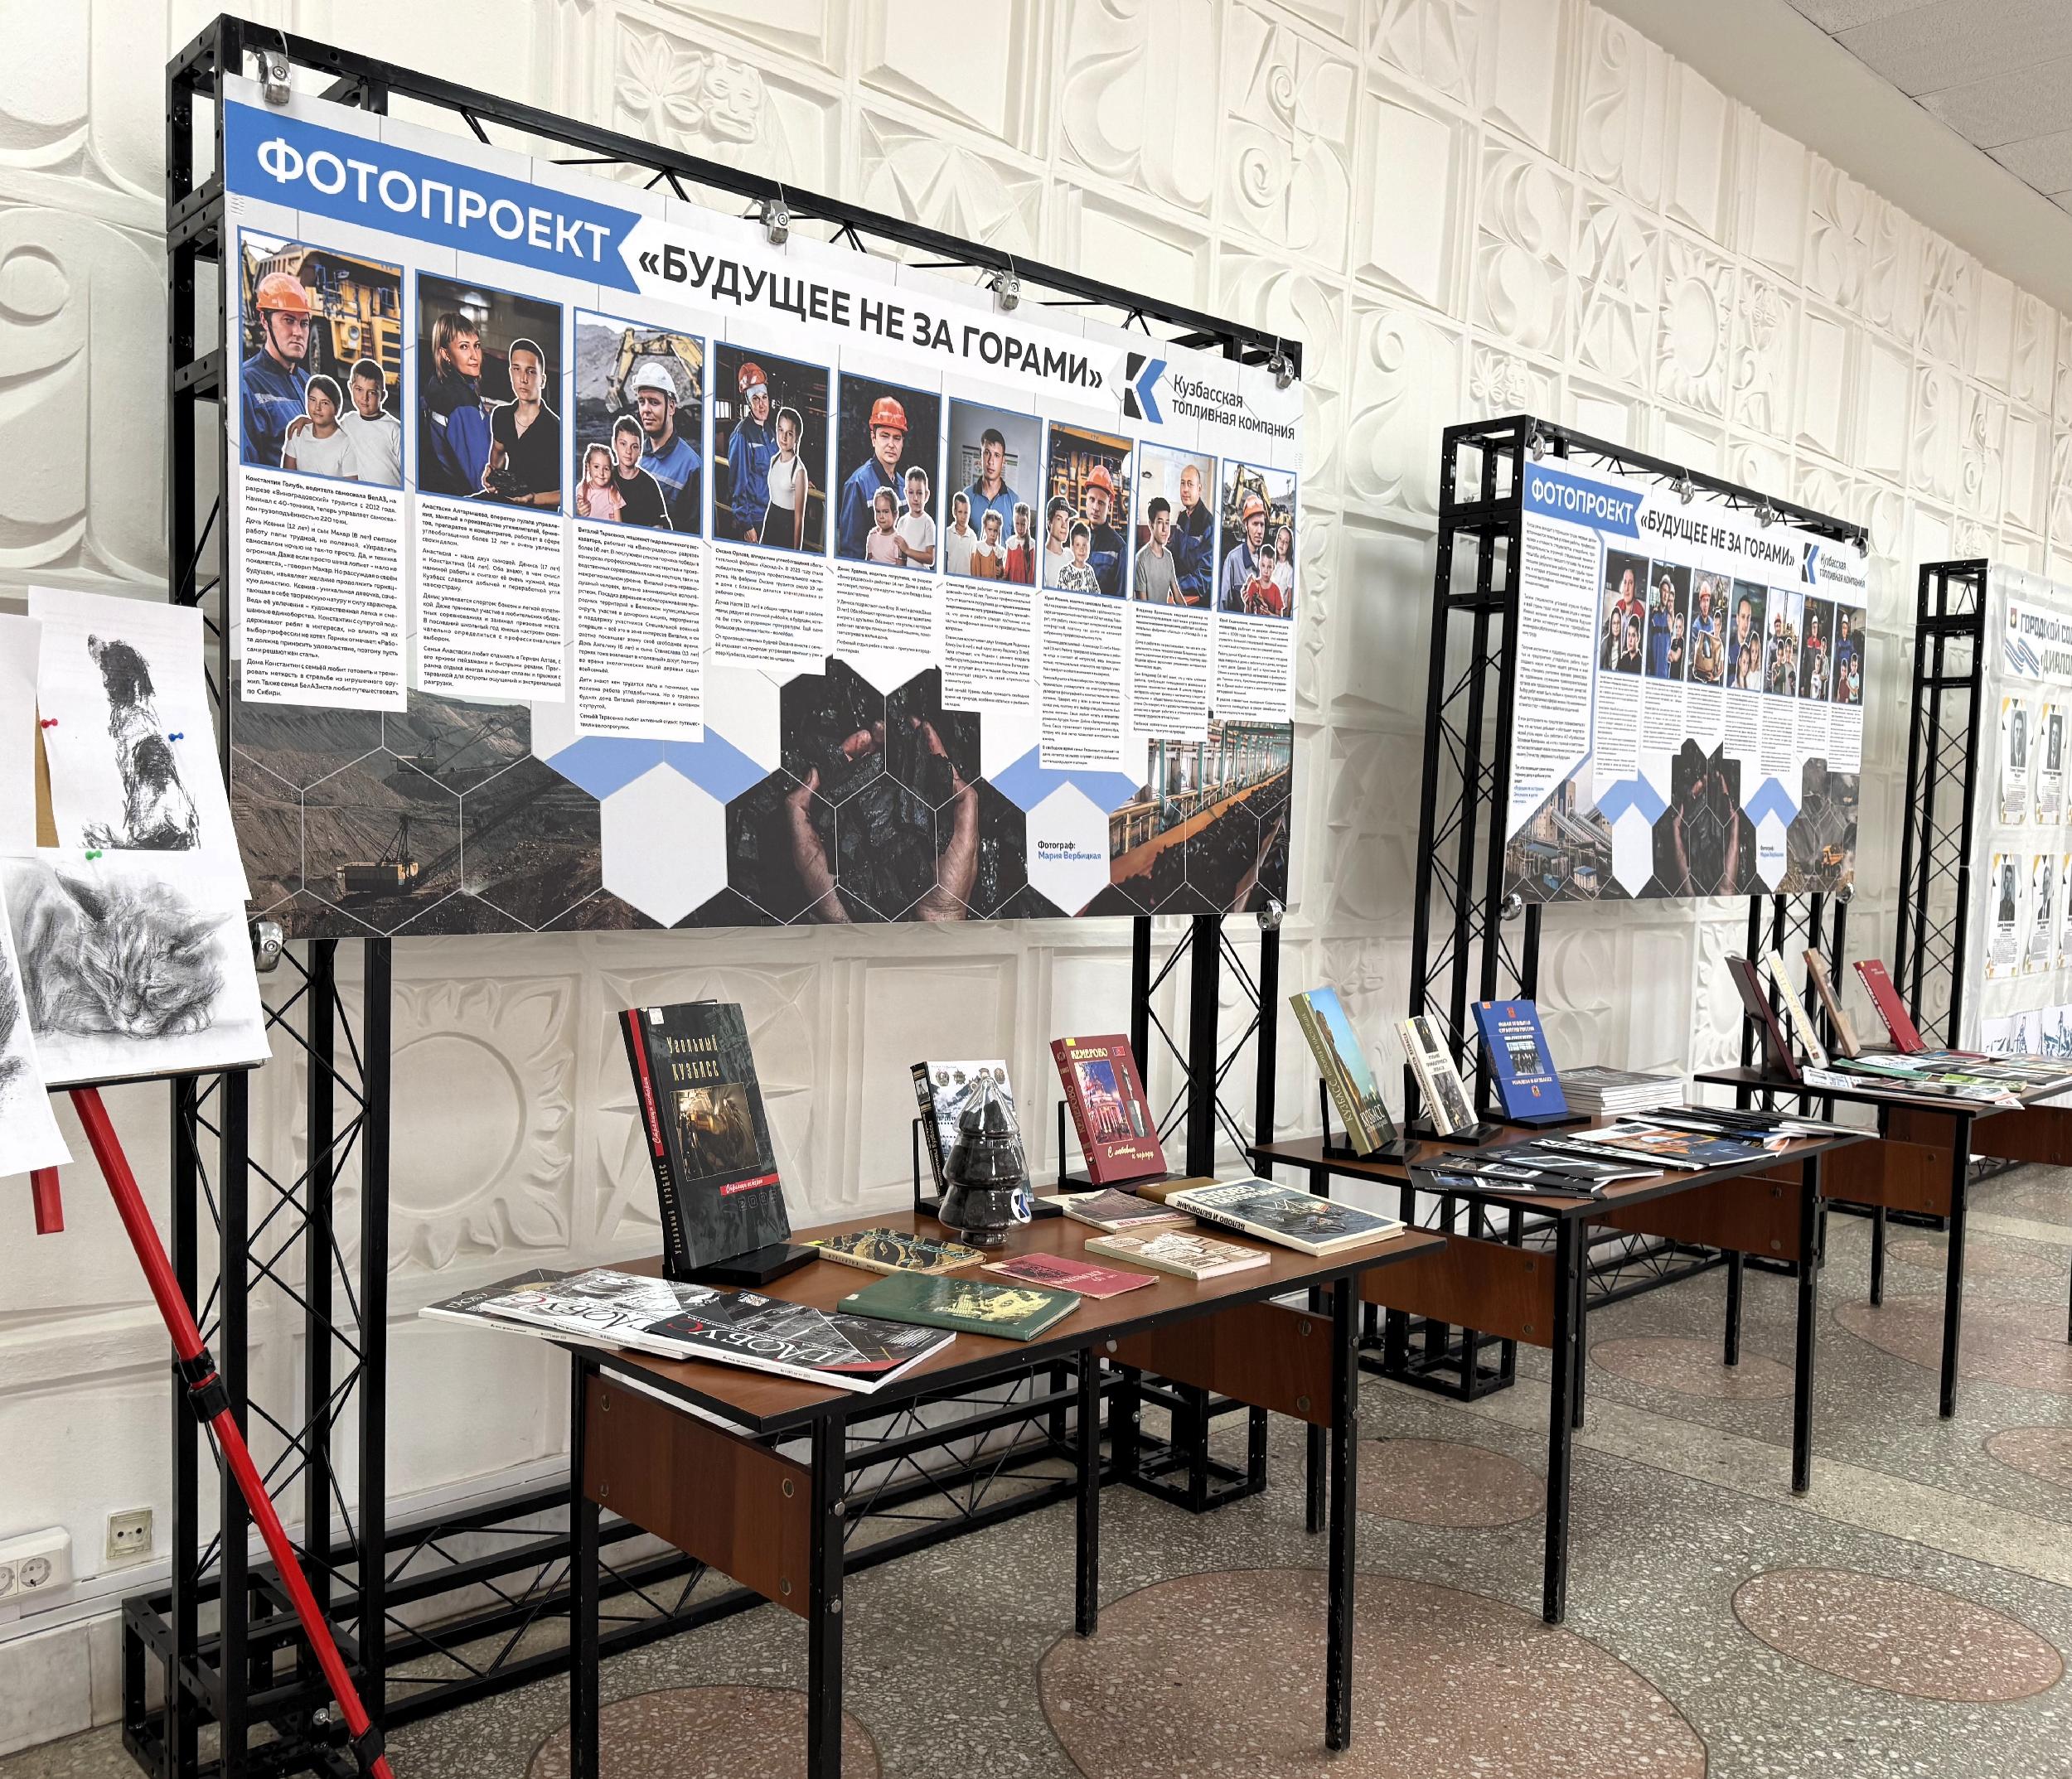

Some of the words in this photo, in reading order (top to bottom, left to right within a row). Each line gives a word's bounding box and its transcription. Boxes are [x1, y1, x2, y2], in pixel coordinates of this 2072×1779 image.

[257, 138, 612, 263] ФОТОПРОЕКТ
[638, 244, 850, 326] «БУДУЩЕЕ
[859, 297, 904, 341] НЕ
[913, 312, 954, 353] ЗА
[963, 327, 1103, 389] ГОРАМИ»
[1174, 374, 1243, 408] Кузбасская
[1172, 399, 1236, 426] топливная
[1238, 416, 1295, 440] компания
[1531, 477, 1634, 525] ФОТОПРОЕКТ
[1641, 510, 1708, 544] «БУДУЩЕЕ
[1711, 526, 1725, 549] НЕ
[1727, 532, 1741, 553] ЗА
[1744, 537, 1795, 567] ГОРАМИ»
[1821, 553, 1847, 570] Кузбасская
[1819, 568, 1843, 583] топливная
[1843, 573, 1866, 588] компания
[1038, 840, 1076, 850] Фотограф:
[1038, 851, 1062, 861] Мария
[1063, 851, 1101, 861] Вербицкая
[1070, 1047, 1108, 1060] КЕМЕРОВО
[672, 1061, 719, 1081] КУЗБАСС
[1329, 1079, 1353, 1122] КУЗБАСС
[1176, 1200, 1212, 1218] БЕЛОВЧАНЕ
[1219, 1215, 1245, 1231] БЕЛОВО
